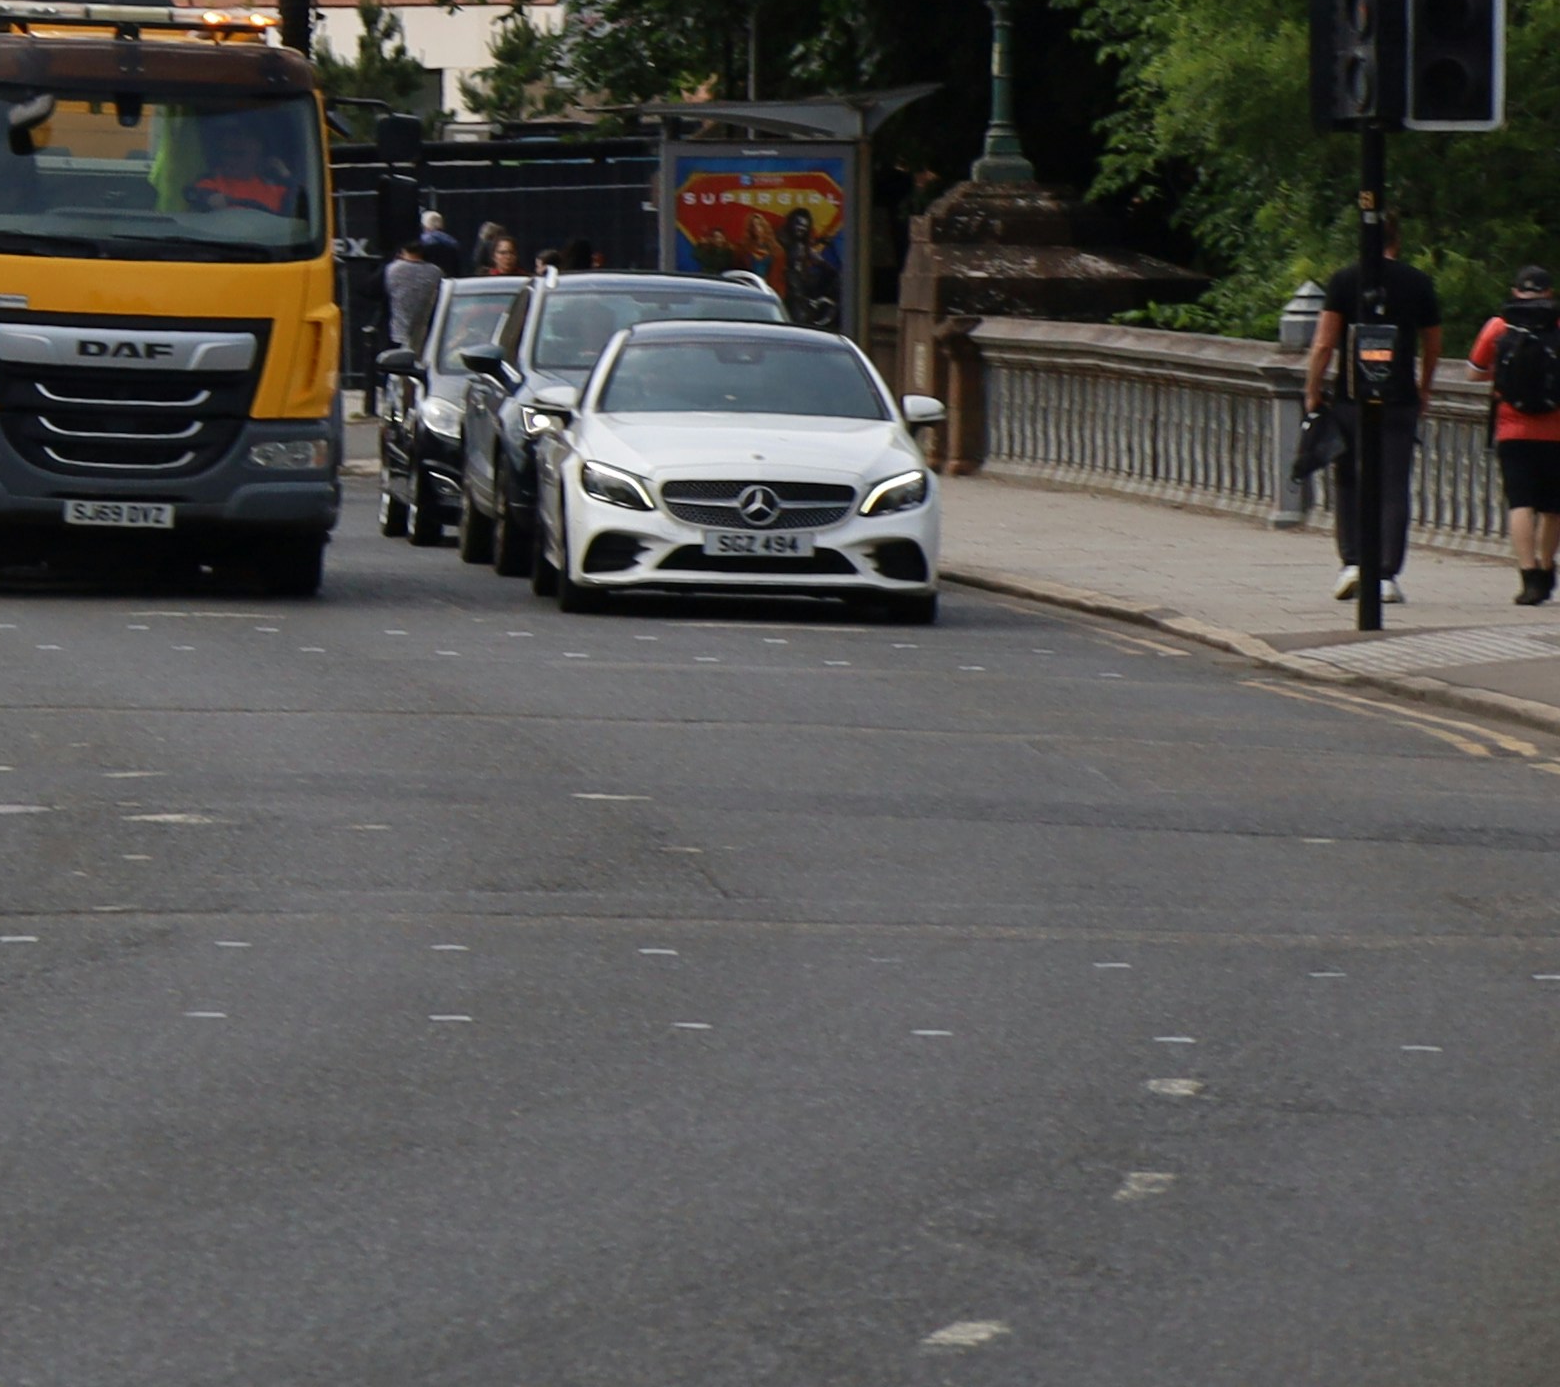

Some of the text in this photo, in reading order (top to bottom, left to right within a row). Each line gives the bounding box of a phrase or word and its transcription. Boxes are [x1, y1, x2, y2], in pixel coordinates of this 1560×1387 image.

[683, 192, 841, 205] SUPERGIRL
[77, 339, 174, 359] DAF
[73, 503, 122, 523] SJ69
[718, 535, 799, 554] SGZ 494
